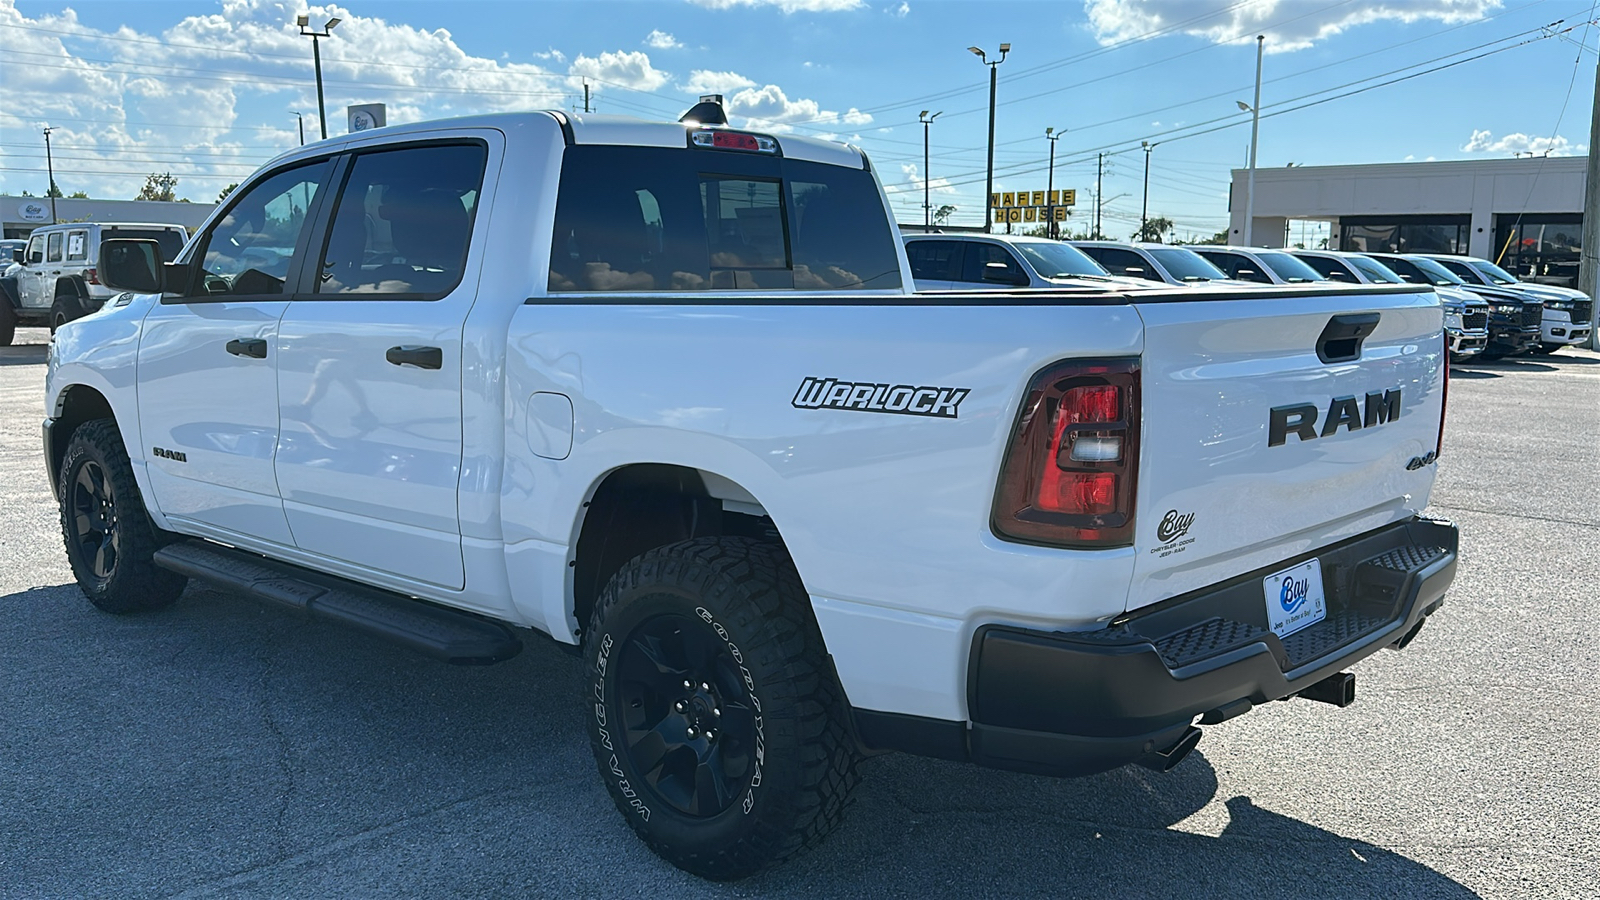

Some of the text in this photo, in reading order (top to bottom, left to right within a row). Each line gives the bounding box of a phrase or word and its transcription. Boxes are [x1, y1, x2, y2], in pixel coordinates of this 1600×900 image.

[996, 209, 1063, 221] HOUSE
[791, 376, 972, 418] WARLOCK
[1268, 387, 1402, 447] RAM
[153, 446, 187, 462] RAM
[1158, 509, 1195, 541] Bay
[1281, 576, 1309, 611] Bay
[594, 633, 651, 822] WRANGLER
[695, 606, 766, 815] GOODYEAR
